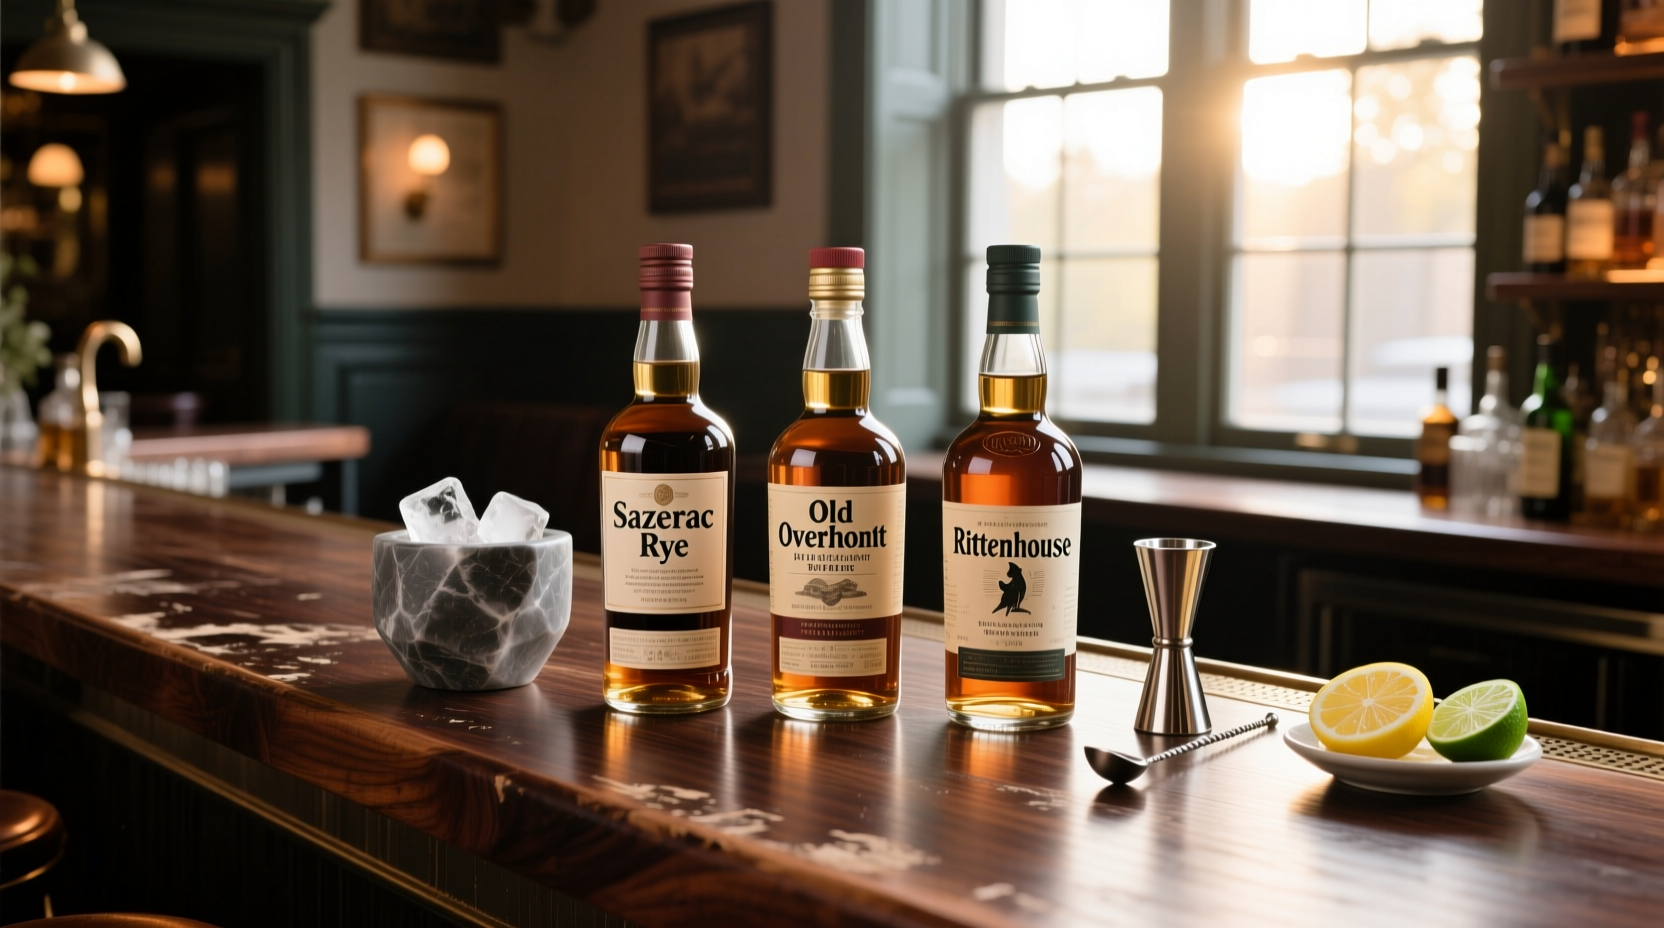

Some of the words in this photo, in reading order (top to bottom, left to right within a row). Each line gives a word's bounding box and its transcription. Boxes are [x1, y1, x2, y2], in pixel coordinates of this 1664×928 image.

[613, 500, 714, 529] Sazerac
[809, 499, 853, 523] Old
[639, 532, 689, 564] Rye
[953, 526, 1072, 558] Rittenhouse
